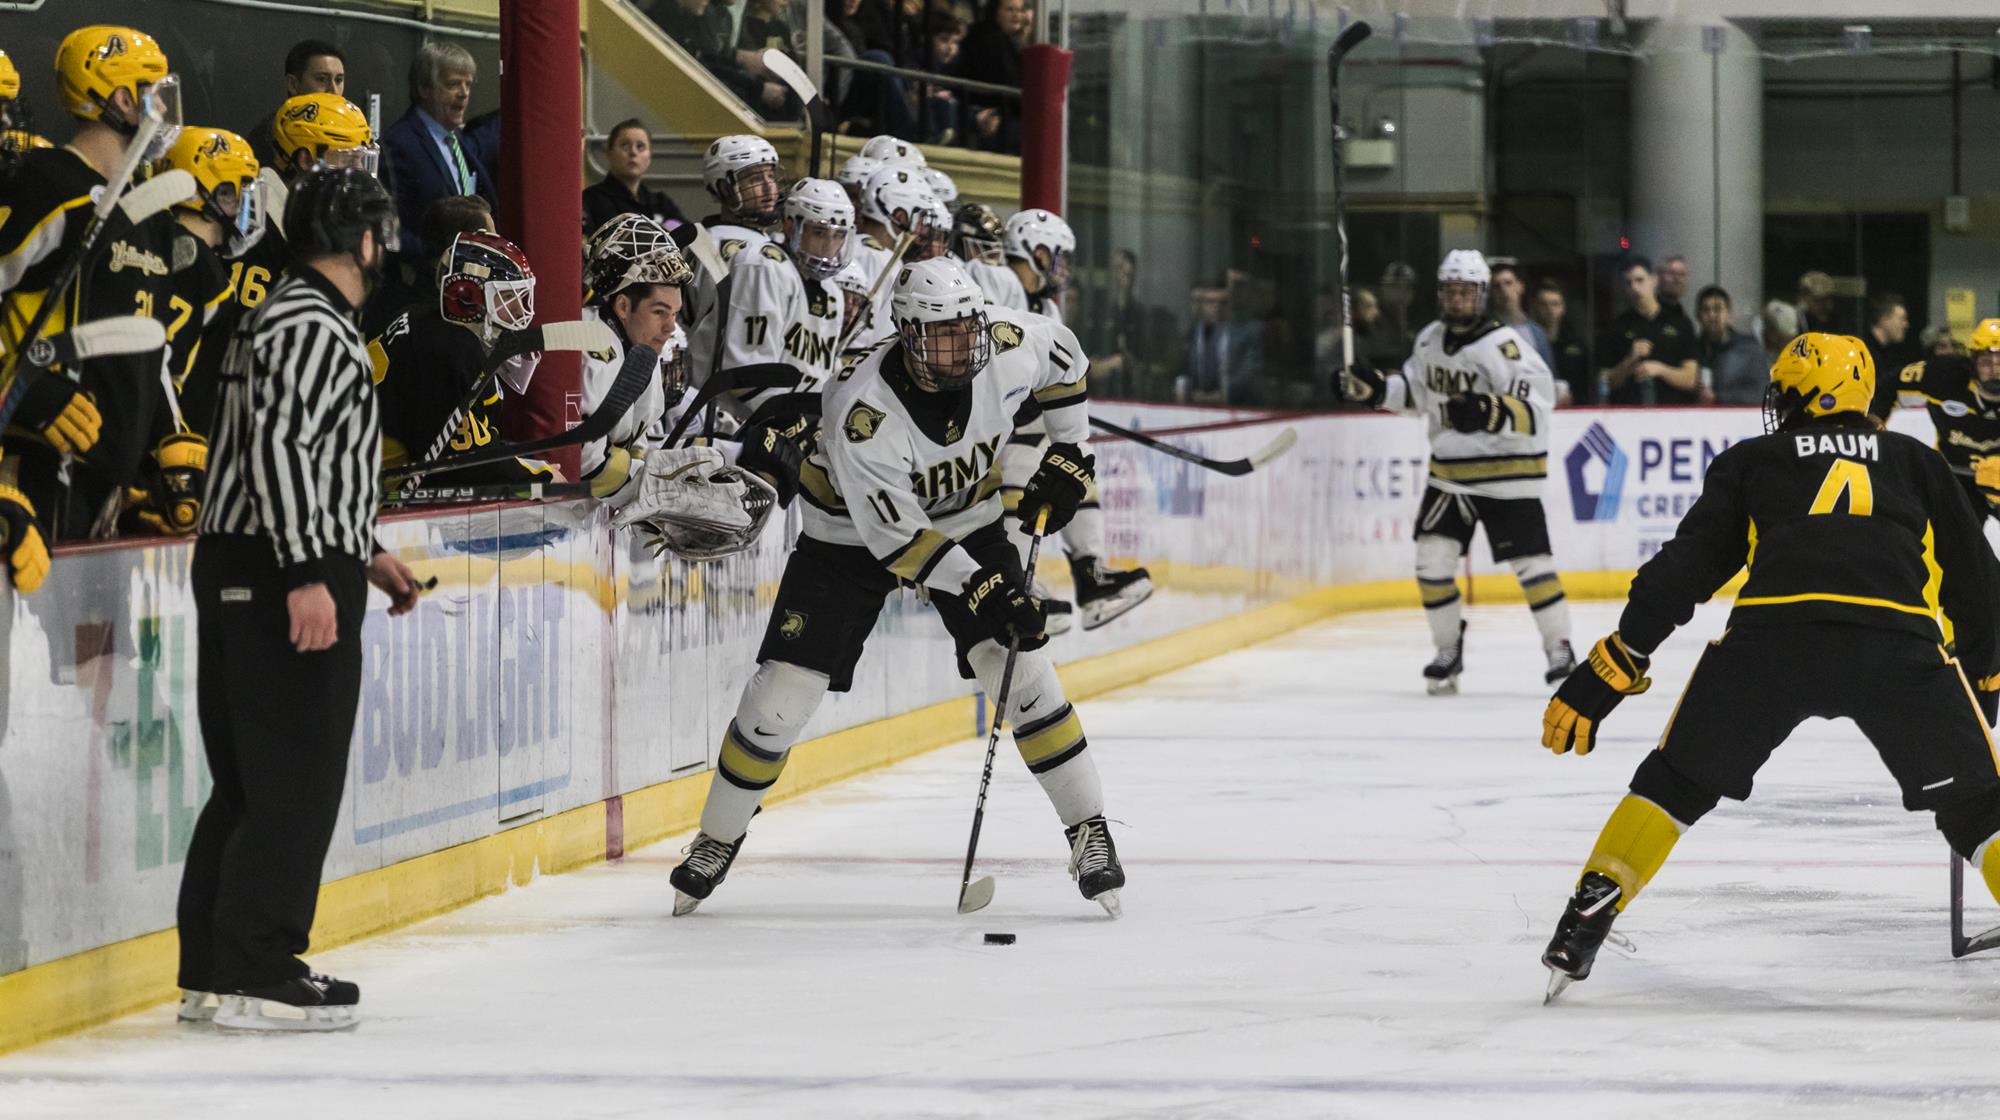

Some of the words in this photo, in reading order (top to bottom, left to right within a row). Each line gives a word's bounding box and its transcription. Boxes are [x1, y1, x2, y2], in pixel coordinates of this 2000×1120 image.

[231, 262, 271, 308] 16
[824, 296, 838, 321] C
[744, 315, 769, 346] 17
[783, 321, 838, 371] ARMY
[1048, 339, 1074, 373] 11
[1426, 364, 1479, 397] ARMY
[1507, 376, 1531, 401] 18
[908, 432, 1002, 499] ARMY
[1639, 438, 1730, 482] PEN
[1795, 433, 1879, 462] BAUM
[1047, 453, 1097, 490] BAUE
[866, 488, 902, 524] 11
[967, 572, 1005, 616] UER
[362, 598, 450, 785] BUD
[455, 580, 565, 764] LIGHT
